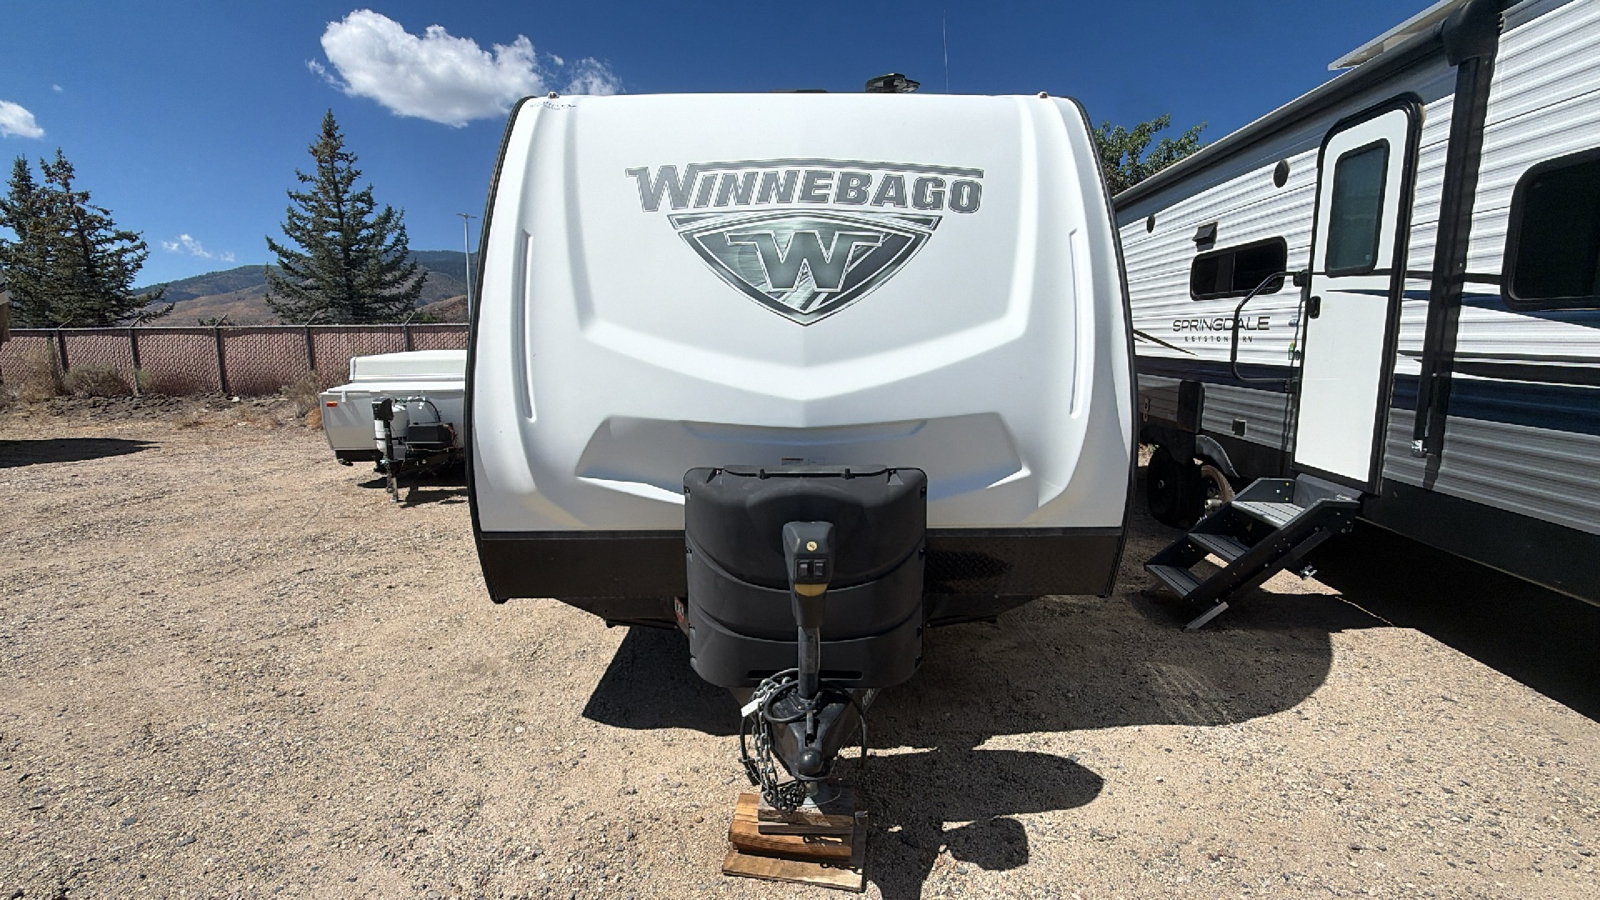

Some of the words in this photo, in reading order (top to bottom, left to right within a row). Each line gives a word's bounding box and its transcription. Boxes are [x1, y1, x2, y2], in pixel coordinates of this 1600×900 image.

[625, 159, 984, 213] WINNEBAGO
[723, 229, 885, 293] W
[1172, 316, 1270, 332] SPRINGDALE
[1242, 335, 1253, 343] RV
